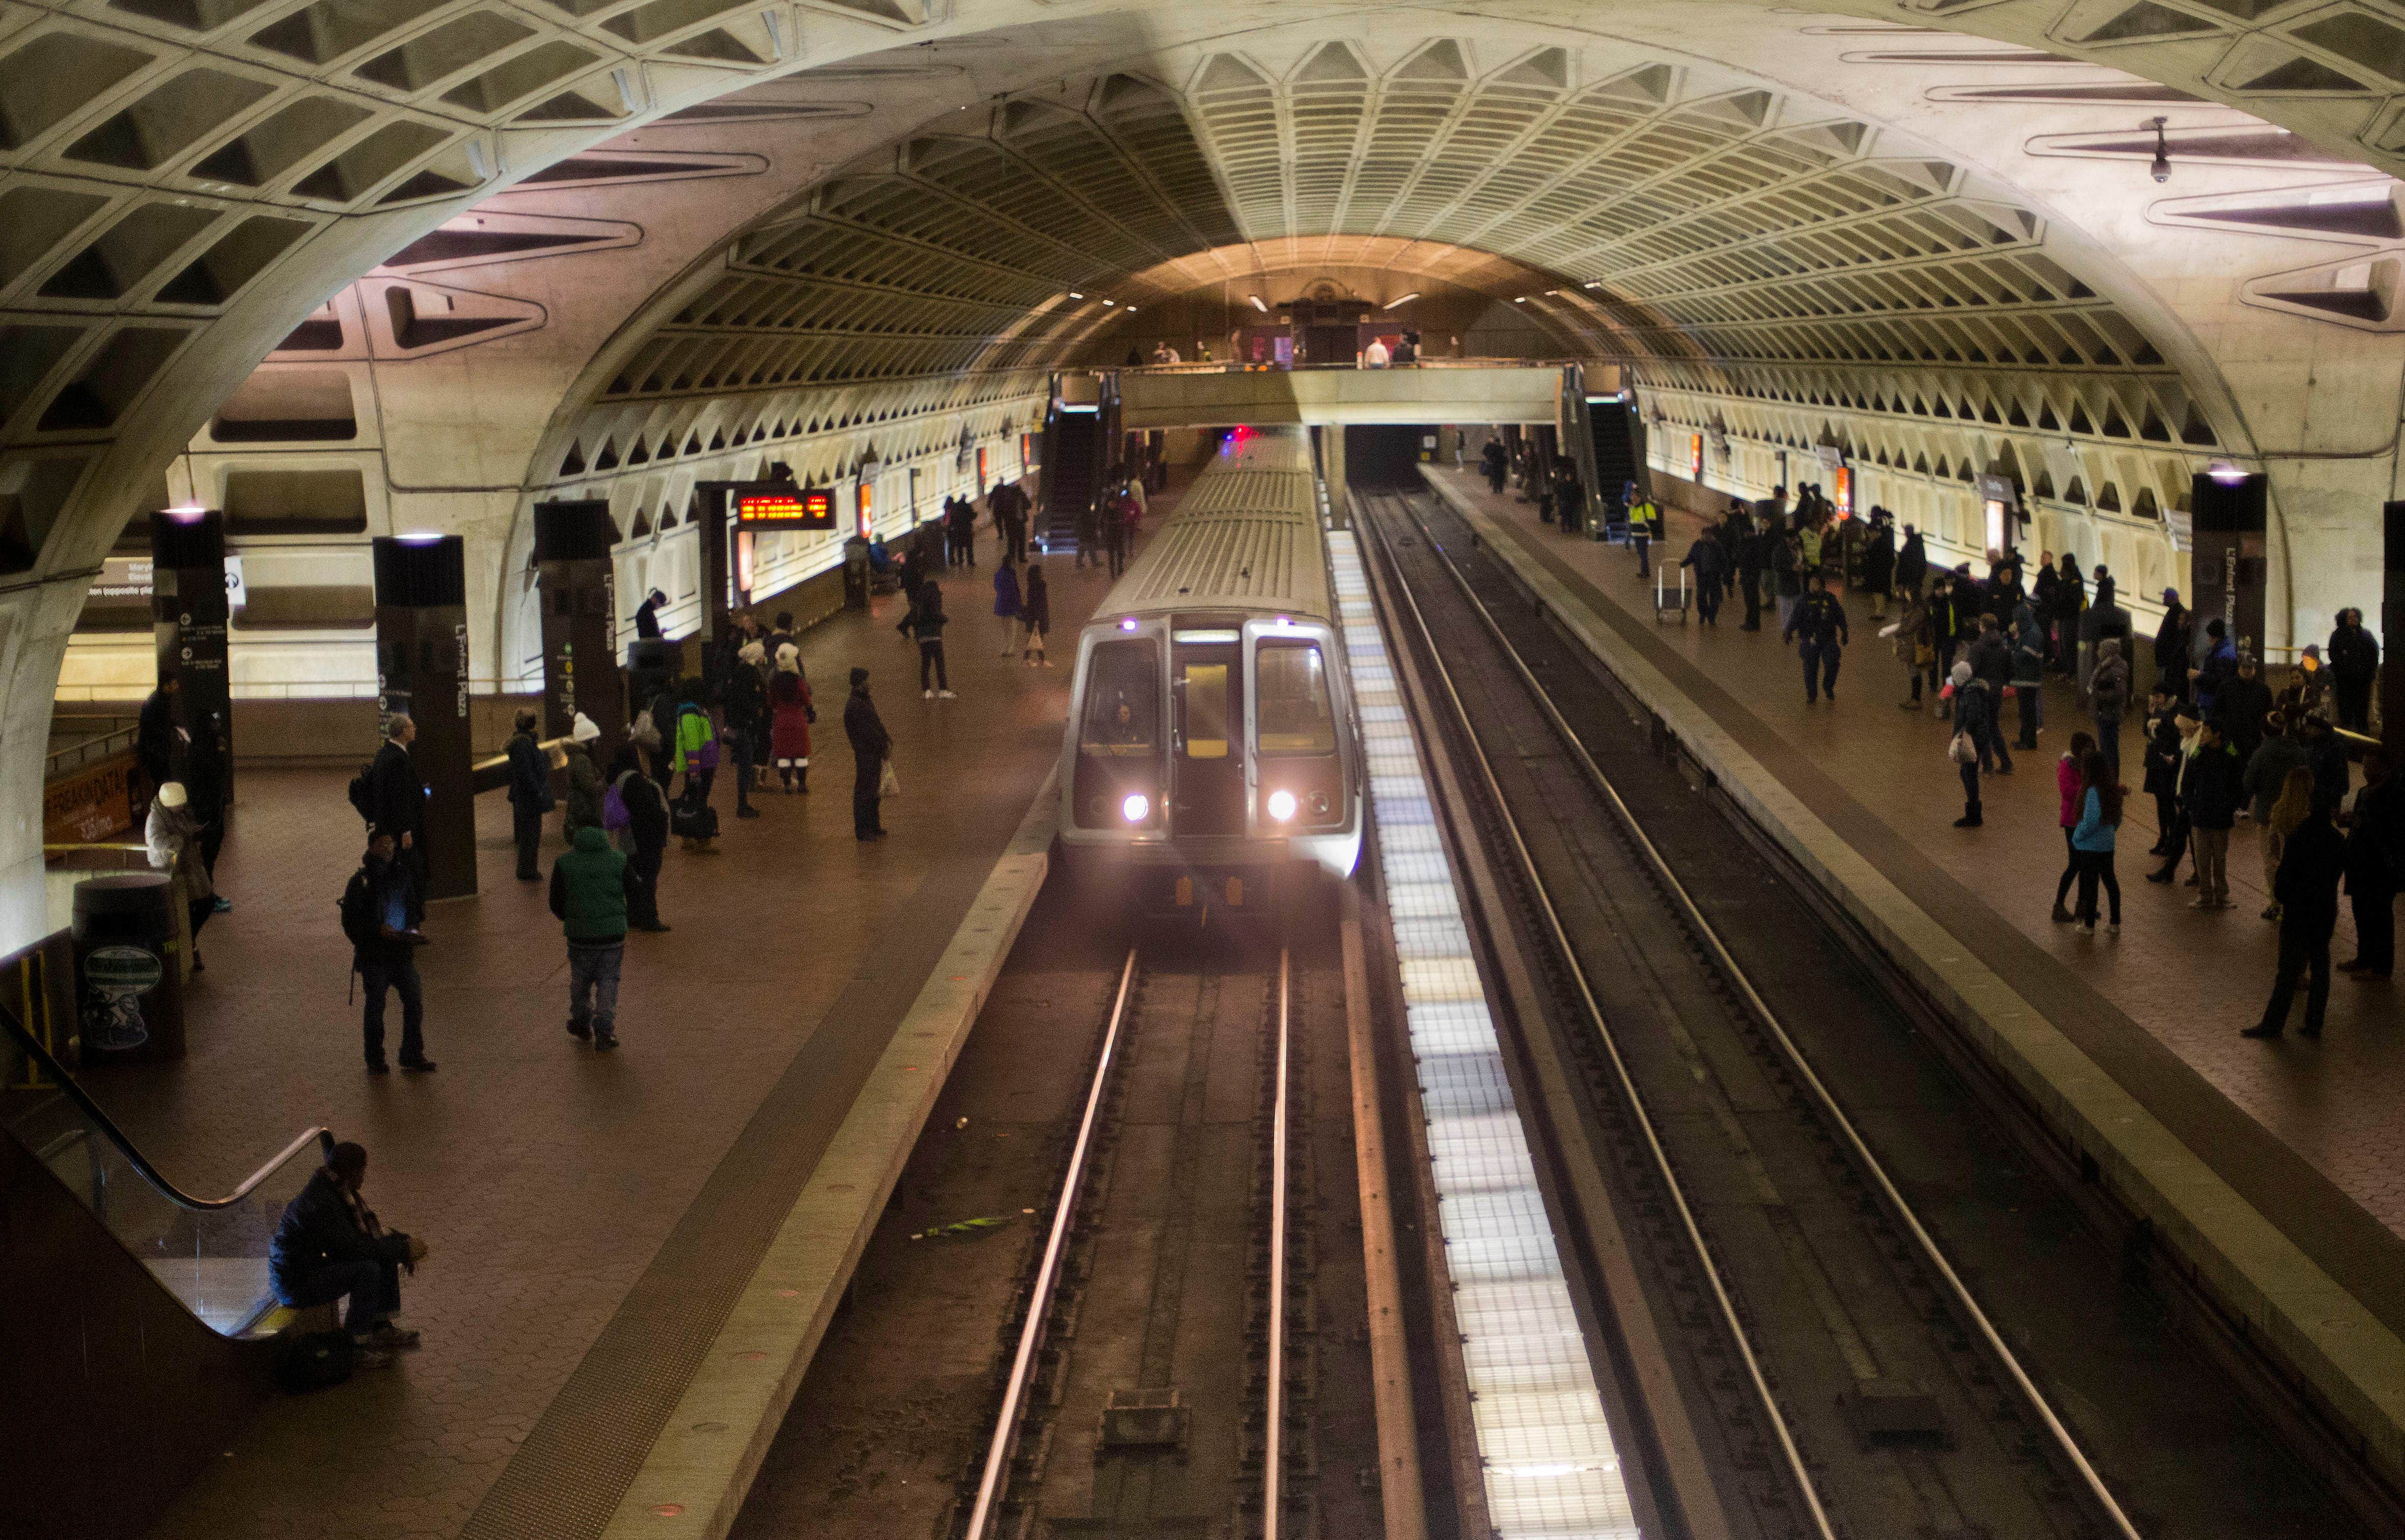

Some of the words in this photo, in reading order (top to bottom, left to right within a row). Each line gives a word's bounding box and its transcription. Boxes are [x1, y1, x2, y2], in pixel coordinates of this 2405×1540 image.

[2227, 547, 2236, 592] L'Enfant
[2226, 594, 2236, 625] Plaza
[457, 681, 468, 718] Plaza
